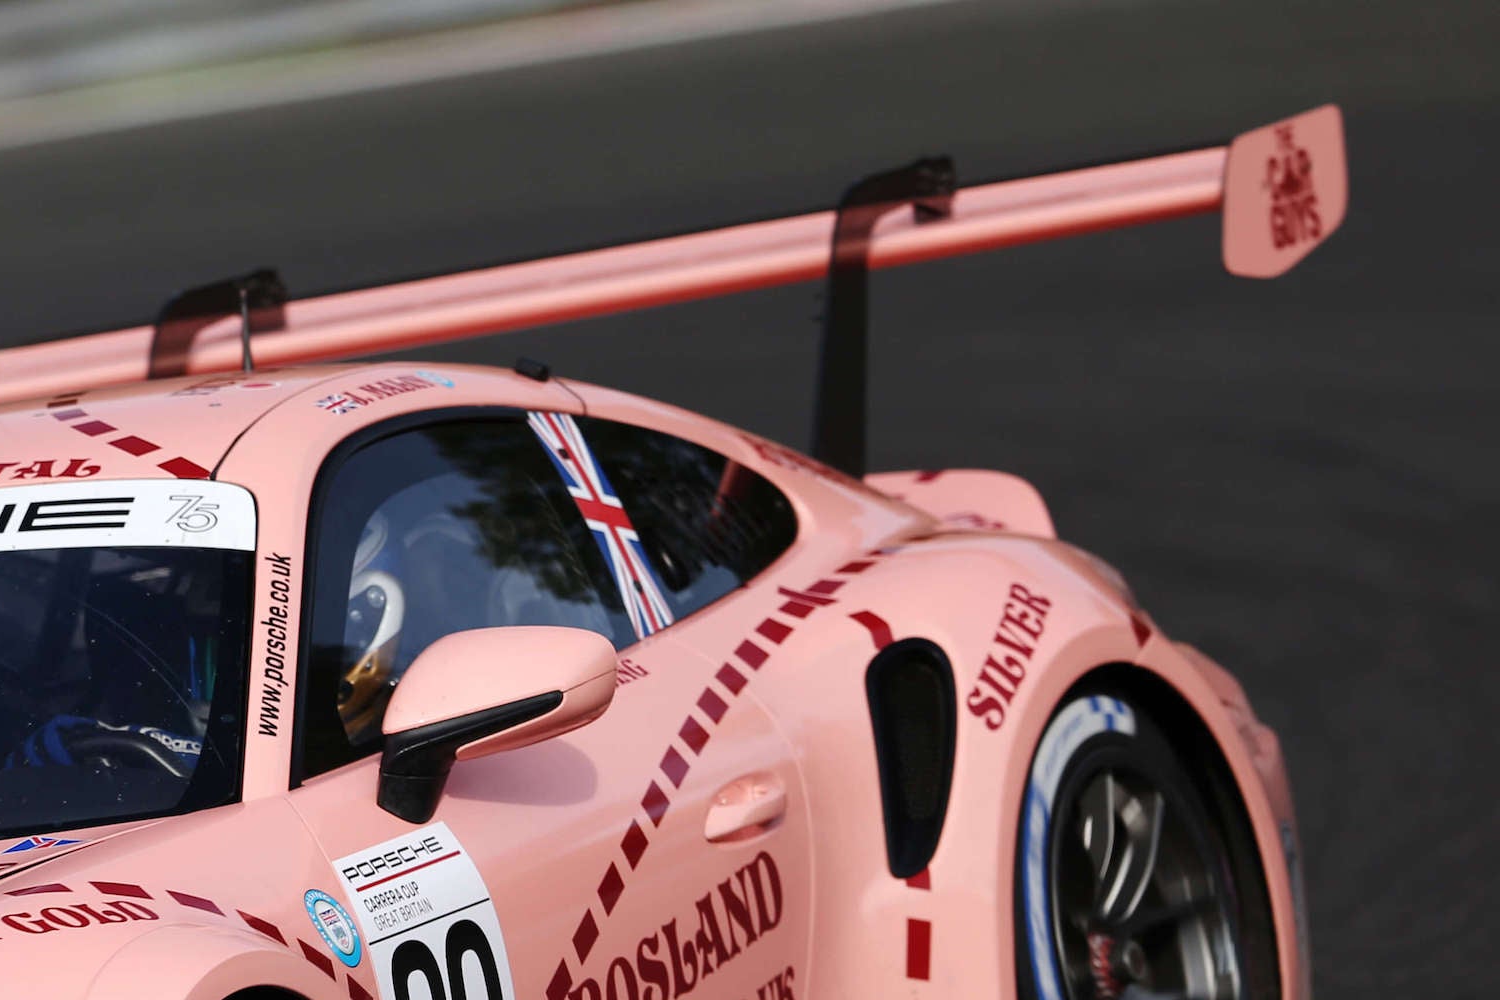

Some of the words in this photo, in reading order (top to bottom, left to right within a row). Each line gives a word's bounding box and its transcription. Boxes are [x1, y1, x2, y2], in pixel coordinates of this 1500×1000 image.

[165, 494, 220, 533] 75
[258, 552, 291, 738] www.porsche.co.uk
[967, 583, 1052, 732] SILVER
[342, 836, 443, 883] PORSCHE
[363, 888, 405, 913] CARRERA
[401, 881, 419, 899] CUP
[373, 909, 401, 931] GREAT
[400, 898, 434, 921] BRITAIN
[1, 900, 160, 934] GOLD
